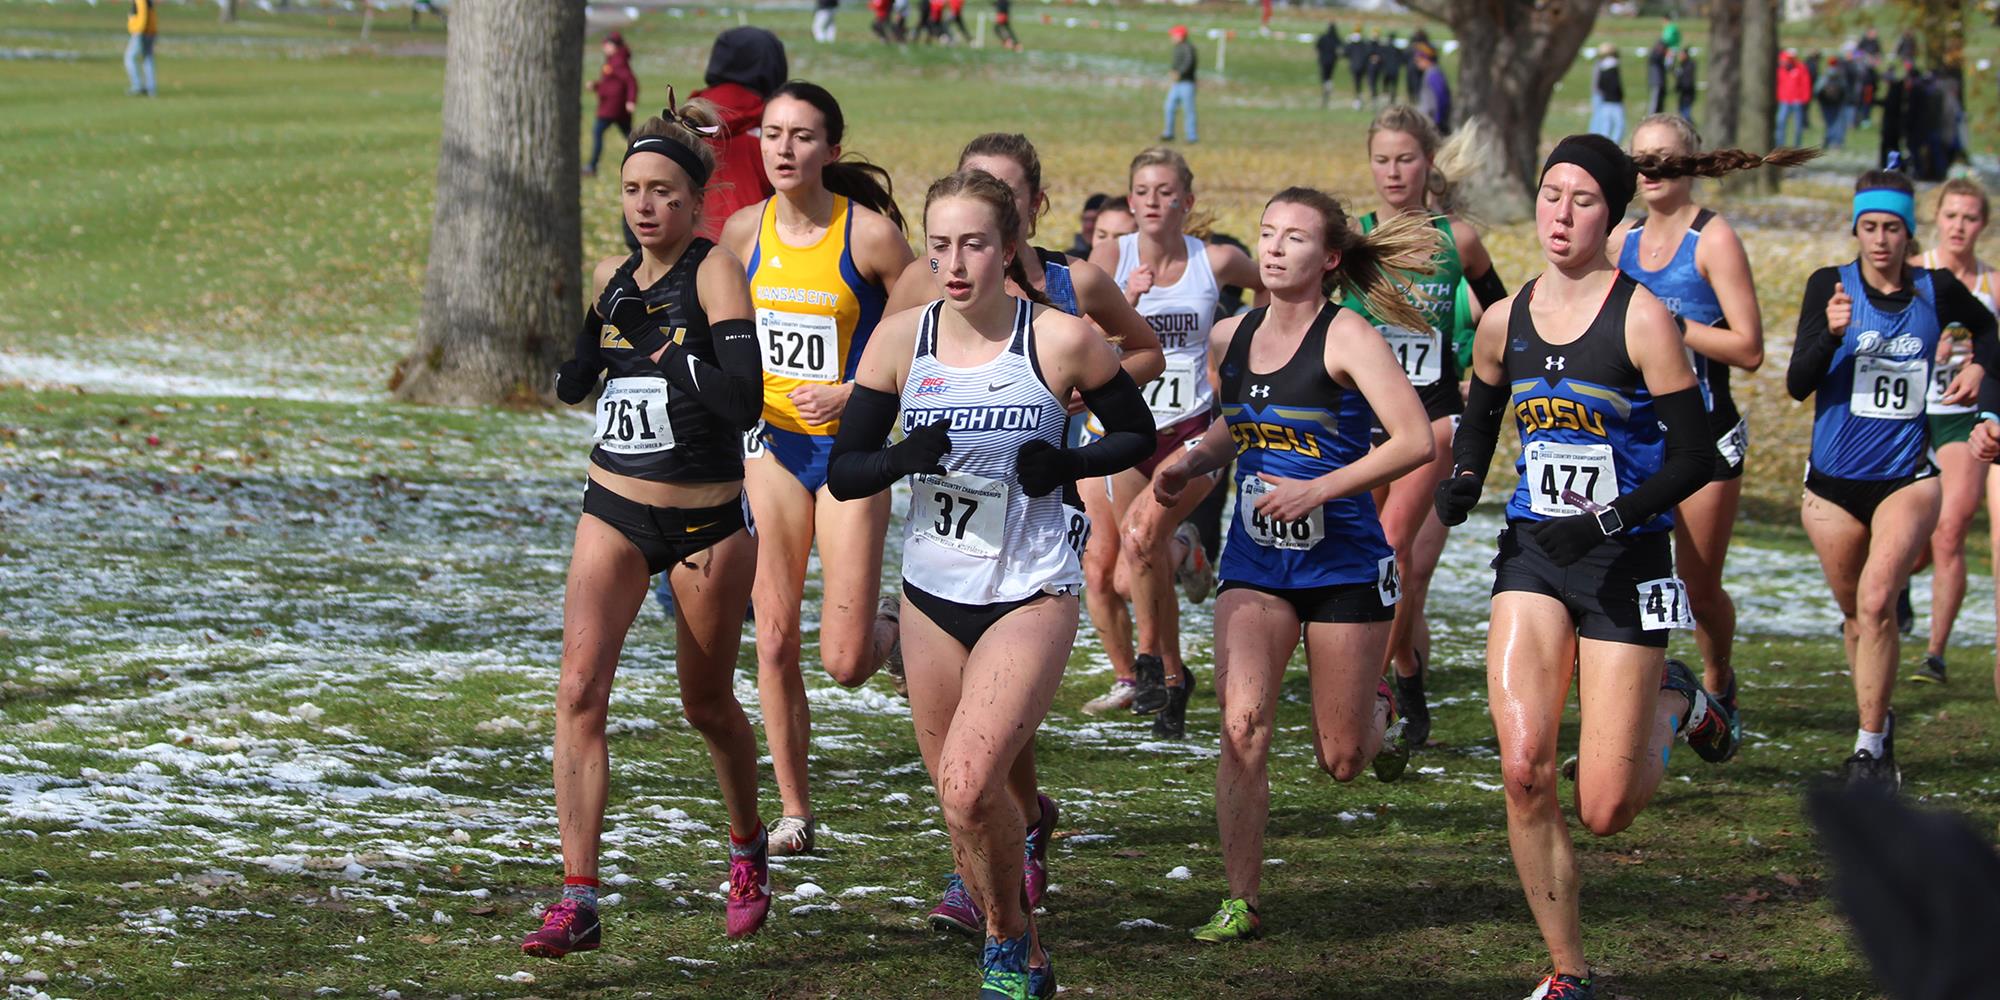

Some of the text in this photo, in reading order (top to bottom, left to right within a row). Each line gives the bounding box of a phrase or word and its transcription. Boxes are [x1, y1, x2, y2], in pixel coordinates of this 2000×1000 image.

[756, 286, 839, 307] KANSAS CITY
[1144, 312, 1200, 332] SSOURI
[768, 329, 825, 371] 520
[1158, 332, 1188, 349] ATE
[1856, 330, 1924, 356] Drake
[1389, 342, 1430, 376] 17
[916, 386, 951, 394] EAST
[921, 377, 945, 386] BIG
[1138, 377, 1182, 408] 71
[1874, 375, 1909, 410] 69
[602, 399, 657, 441] 261
[1515, 397, 1608, 437] SDSU
[1228, 422, 1323, 459] SDSU
[941, 480, 962, 491] COUNTRY
[961, 486, 1001, 499] CHAMPIONSHIPS
[1540, 463, 1600, 506] 477
[933, 492, 978, 540] 37
[1067, 513, 1091, 562] 8
[1383, 560, 1398, 598] 4
[1647, 582, 1691, 623] 47
